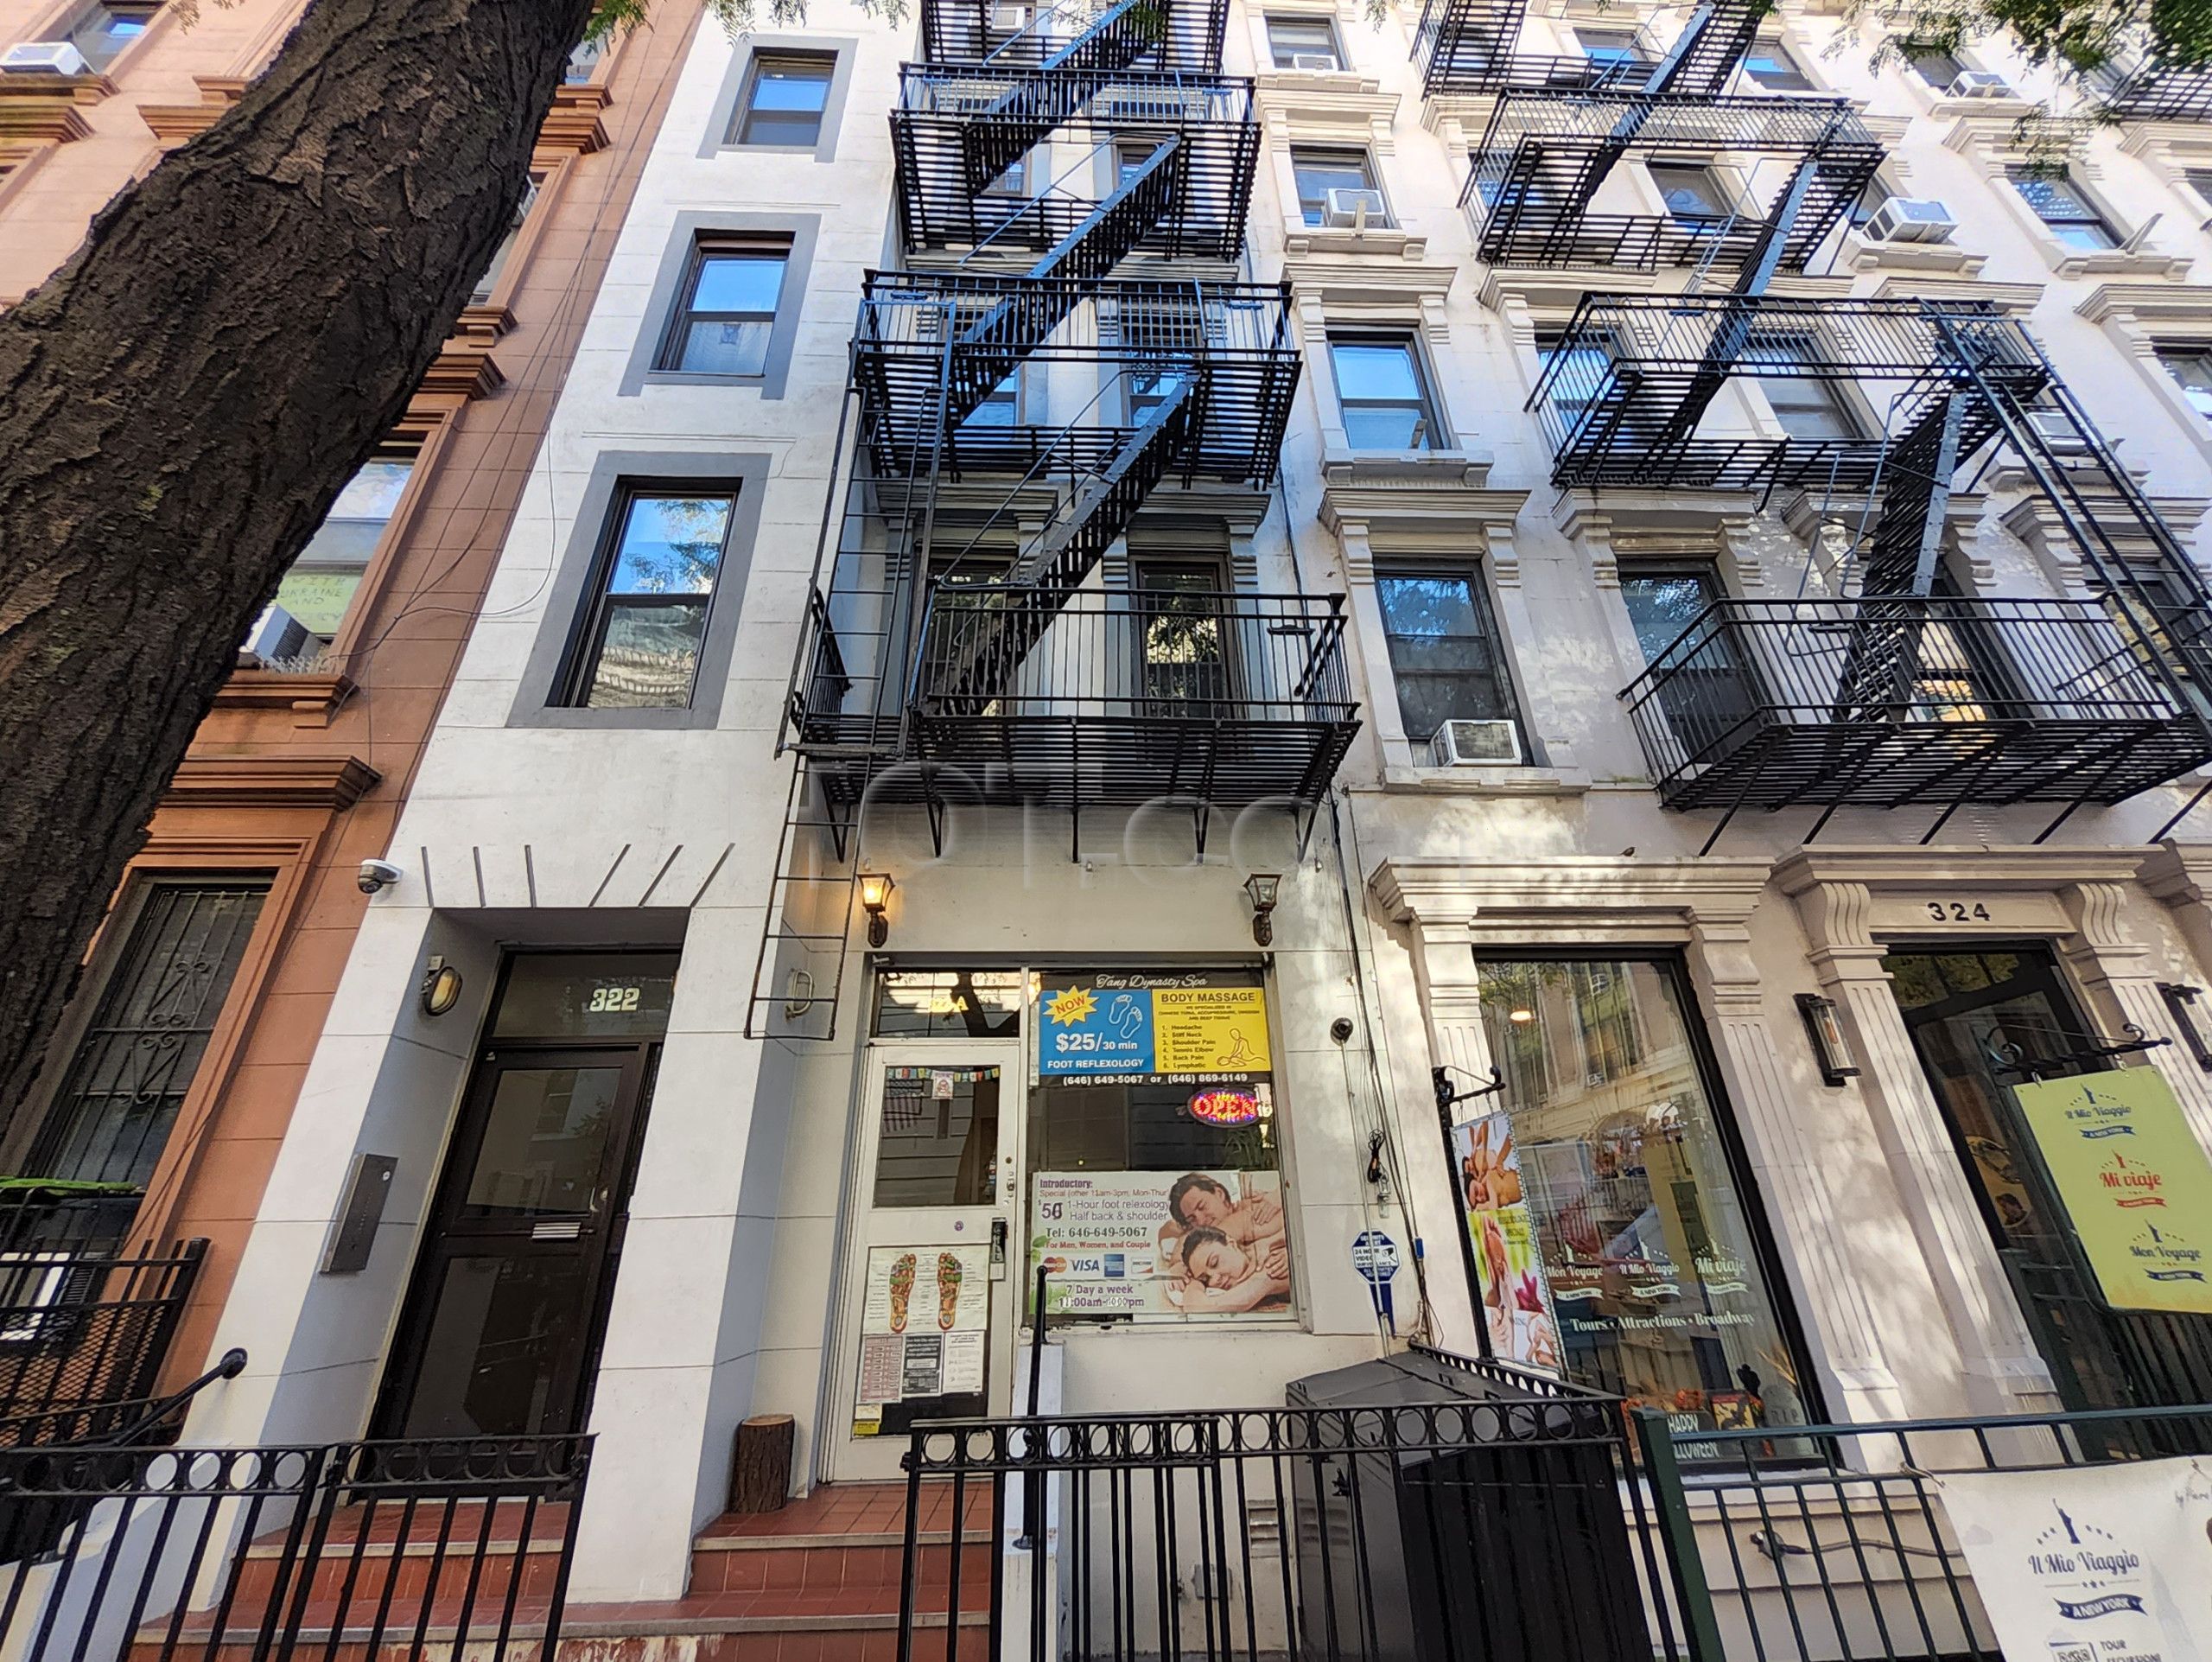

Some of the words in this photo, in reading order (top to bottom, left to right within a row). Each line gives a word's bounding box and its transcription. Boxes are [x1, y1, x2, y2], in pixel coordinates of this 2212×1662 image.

[1928, 902, 1991, 921] 324
[1096, 974, 1127, 989] Tang
[1128, 974, 1180, 989] Dynasty
[1181, 973, 1208, 988] Spa
[589, 987, 640, 1012] 322
[1055, 995, 1085, 1014] NOW
[1161, 993, 1194, 1003] BODY
[1198, 992, 1255, 1002] MASSAGE
[1118, 1041, 1137, 1050] min
[1047, 1060, 1073, 1069] FOOT
[1075, 1059, 1144, 1068] REFLEXOLOGY
[1063, 1076, 1091, 1086] (646)
[1094, 1075, 1143, 1085] 649-5067
[1168, 1074, 1196, 1084] (646)
[1194, 1097, 1257, 1117] OPEN
[2093, 1104, 2132, 1118] Viaggio
[1039, 1179, 1093, 1189] Introductory:
[2100, 1172, 2122, 1188] Mi
[2123, 1170, 2162, 1191] viaje
[1039, 1189, 1065, 1198] Special
[1102, 1200, 1120, 1209] foot
[1071, 1212, 1090, 1221] Half
[1091, 1212, 1114, 1220] back
[1127, 1211, 1167, 1220] shoulder
[1046, 1227, 1065, 1237] Tel:
[1068, 1226, 1147, 1238] 646-649-5067
[1126, 1240, 1151, 1250] Couple
[2155, 1245, 2201, 1261] Voyage
[1071, 1259, 1100, 1271] VISA
[1545, 1265, 1567, 1277] Mon
[1567, 1264, 1604, 1280] Voyage
[1630, 1264, 1644, 1275] Mio
[1646, 1262, 1680, 1276] Viaggio
[1695, 1257, 1713, 1274] Mi
[1715, 1257, 1747, 1277] viaje
[1066, 1285, 1072, 1294] 7
[1076, 1284, 1095, 1296] Day
[1107, 1283, 1133, 1294] week
[1569, 1318, 1609, 1332] Tours
[1617, 1313, 1685, 1330] Attractions
[1694, 1310, 1754, 1328] Broadway
[1668, 1413, 1700, 1433] HAPPY
[2028, 1555, 2044, 1574] Il
[2045, 1553, 2075, 1574] Mio
[2077, 1548, 2139, 1576] Viaggio
[2100, 1640, 2126, 1651] TOUR
